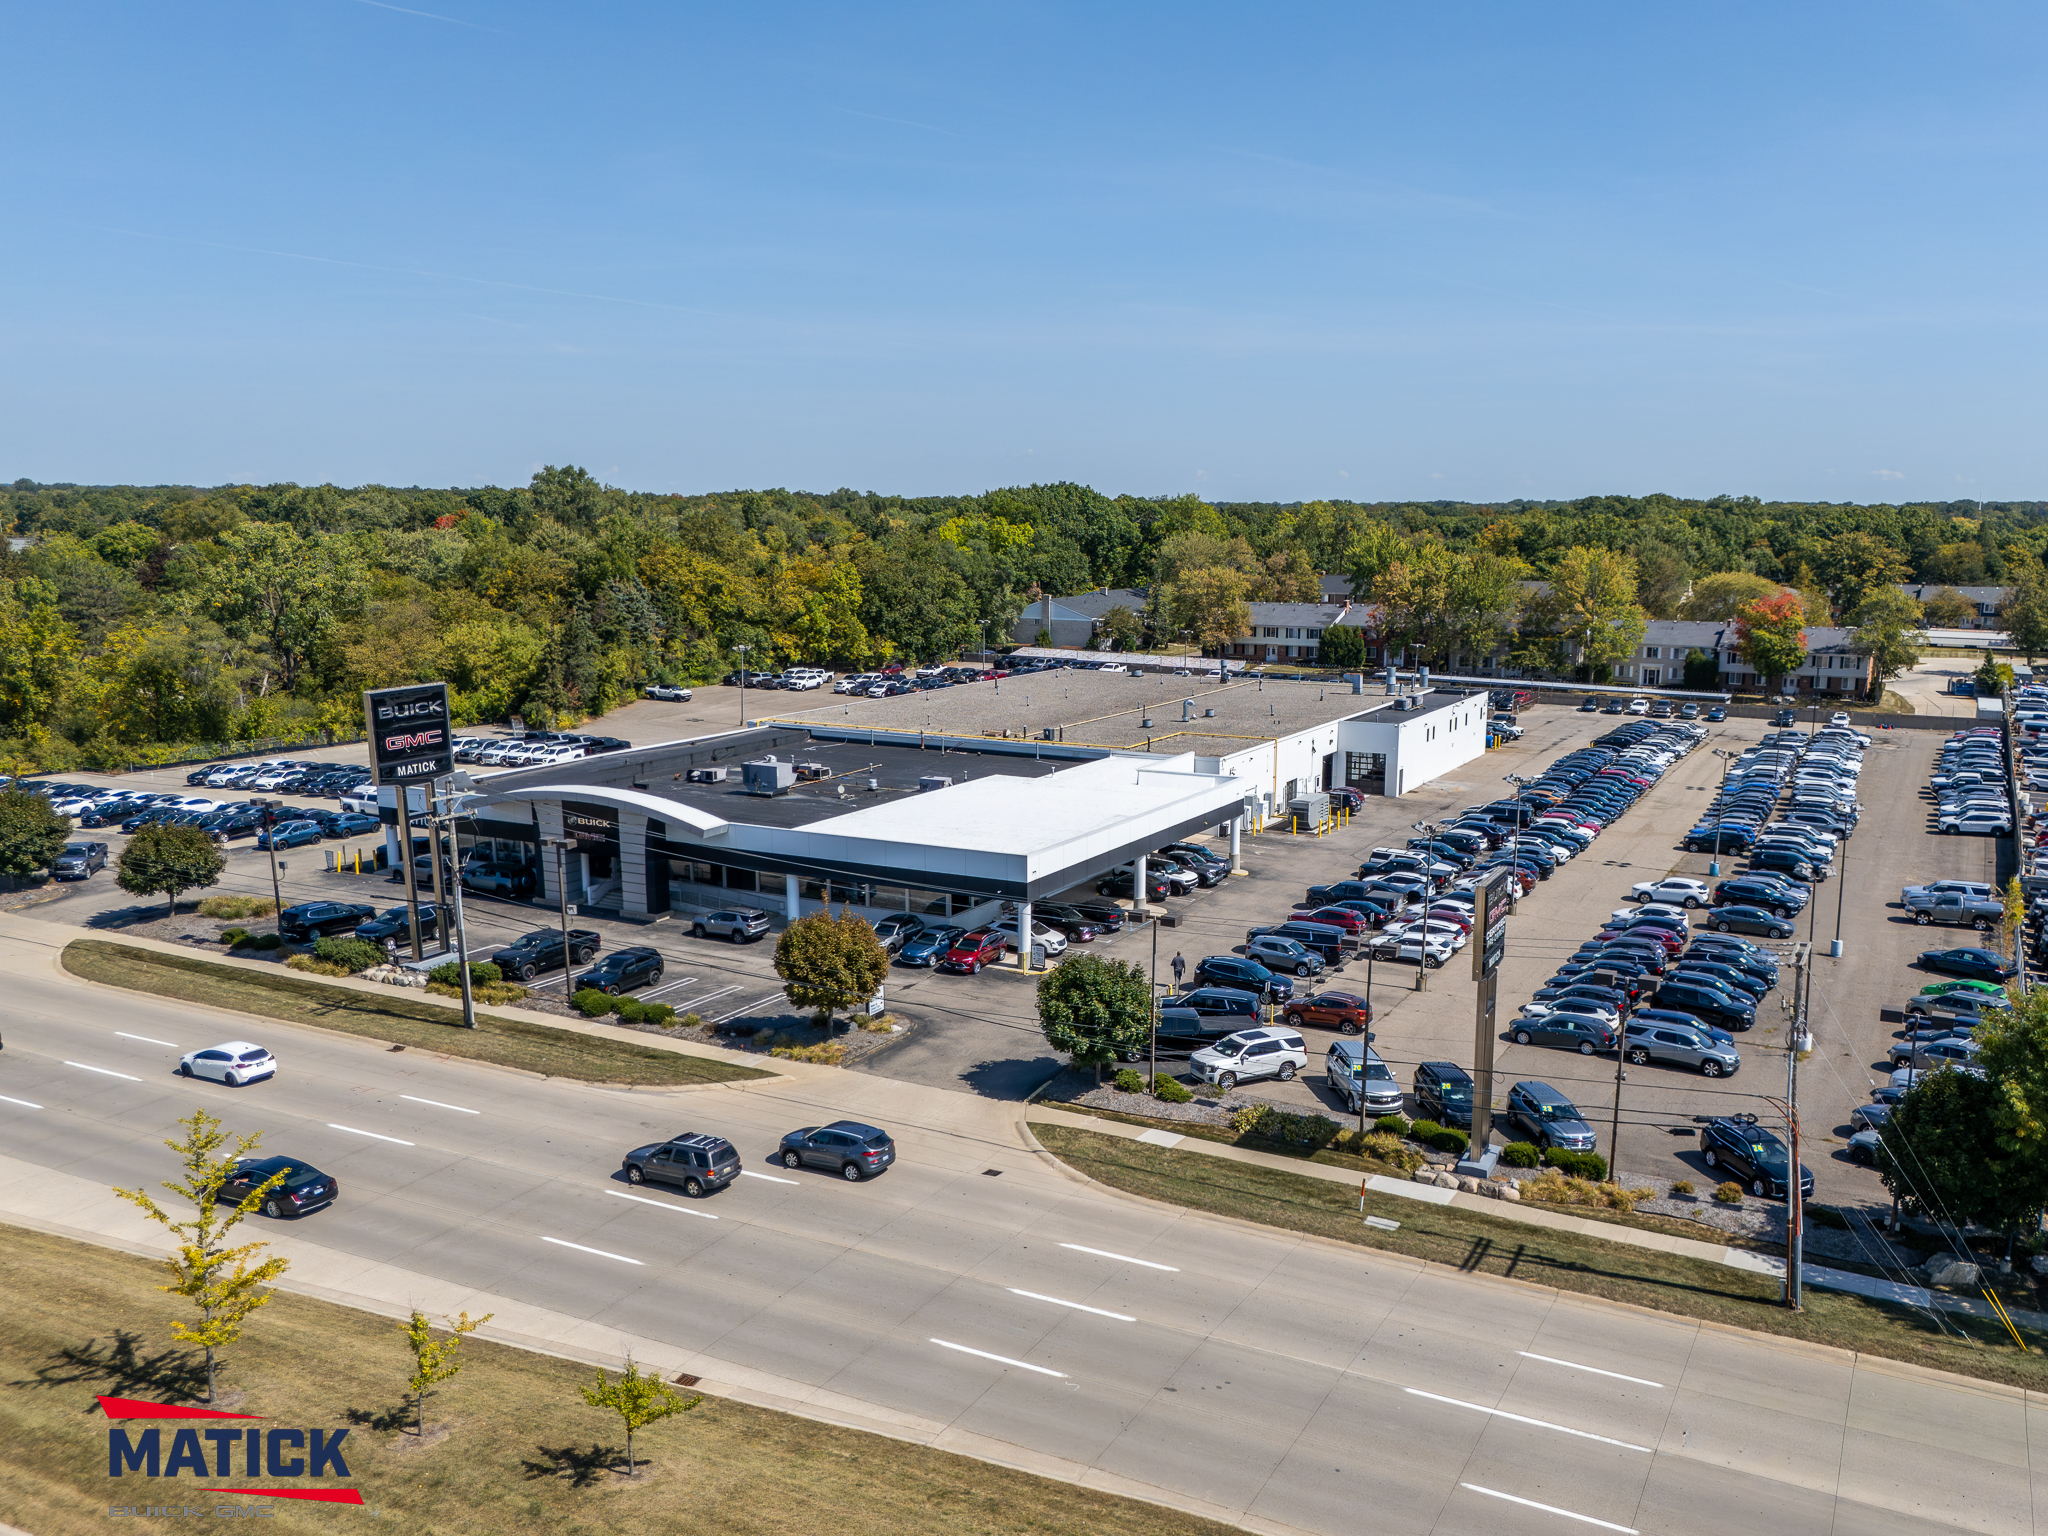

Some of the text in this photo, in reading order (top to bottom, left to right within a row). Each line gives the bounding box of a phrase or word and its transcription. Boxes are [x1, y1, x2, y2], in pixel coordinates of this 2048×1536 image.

[378, 700, 445, 720] BUICK
[386, 730, 443, 751] GMC
[397, 760, 437, 777] MATICK
[577, 817, 610, 828] BUICK
[1488, 897, 1507, 925] GMC
